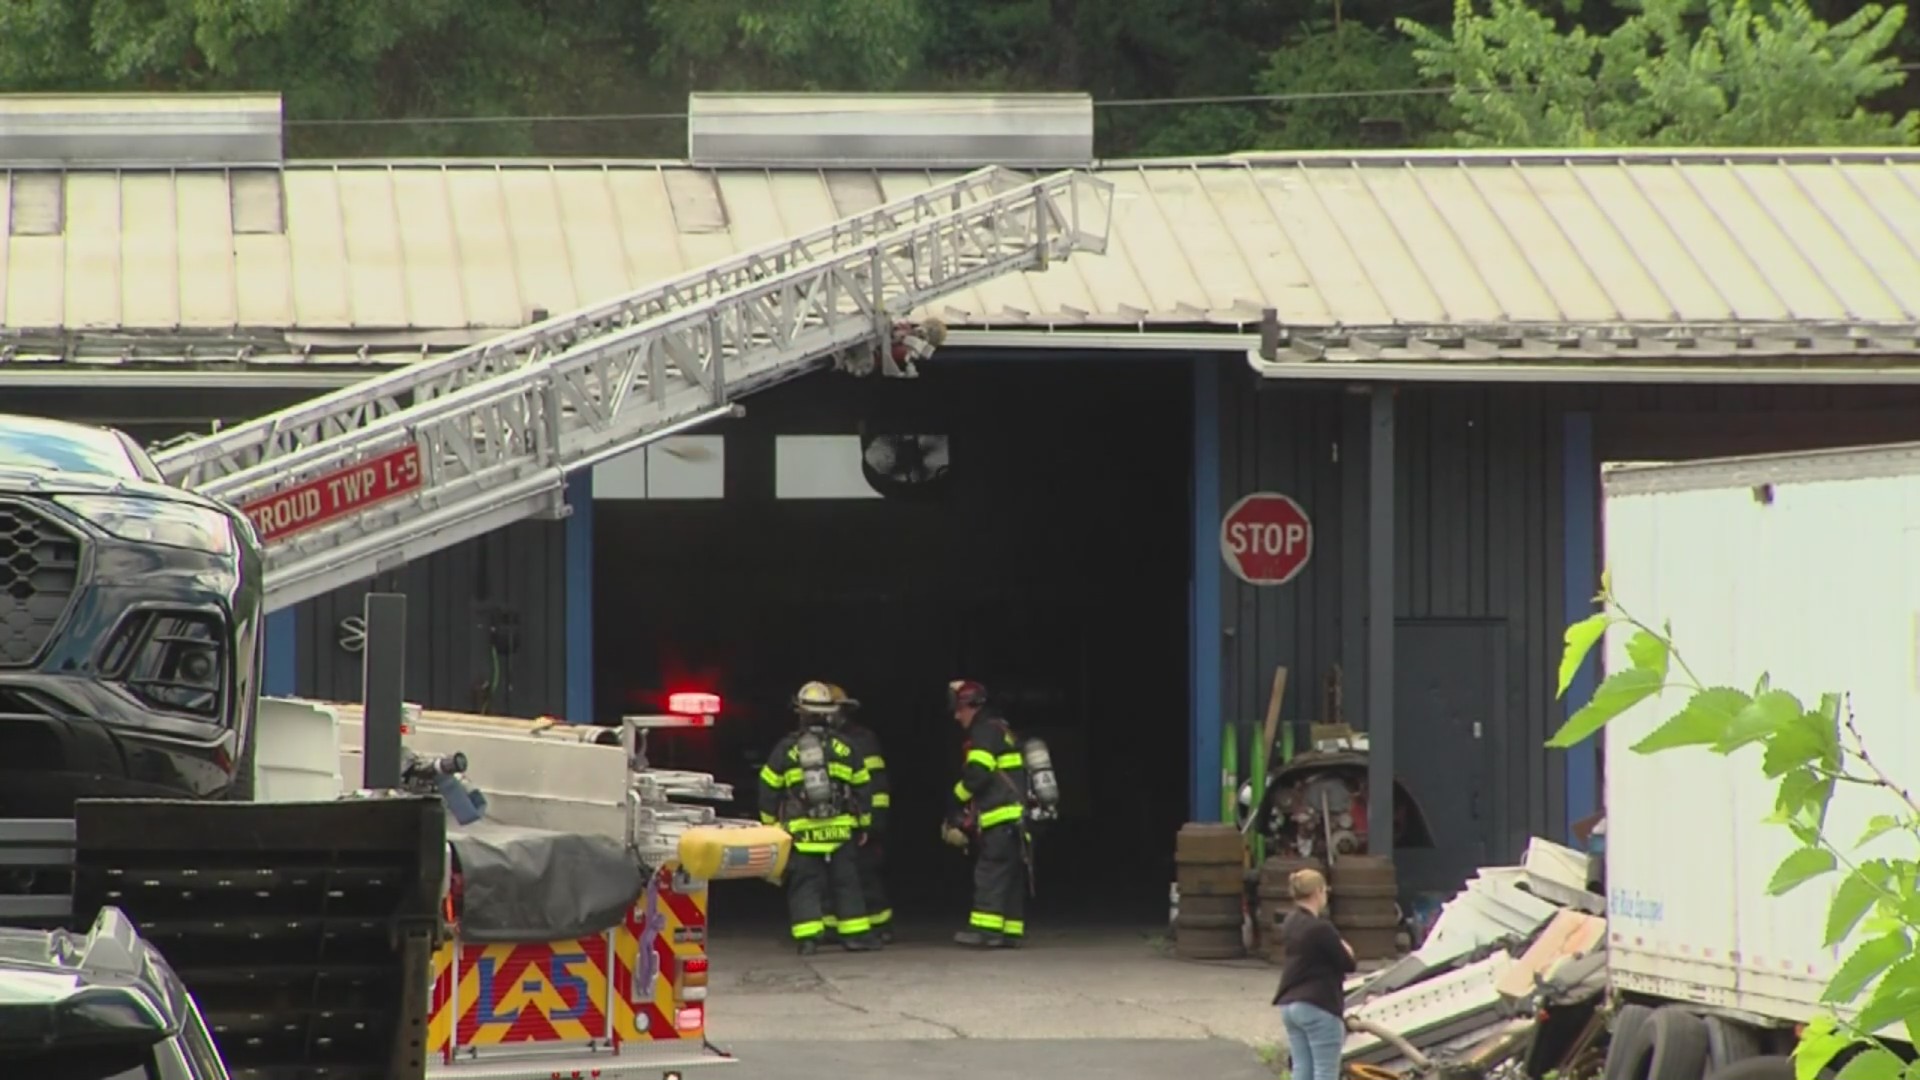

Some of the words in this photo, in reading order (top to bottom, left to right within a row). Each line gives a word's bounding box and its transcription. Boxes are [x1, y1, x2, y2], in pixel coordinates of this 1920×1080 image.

[328, 468, 377, 508] TWP
[384, 453, 419, 490] L-5
[1230, 522, 1304, 555] STOP
[477, 954, 588, 1023] L-5
